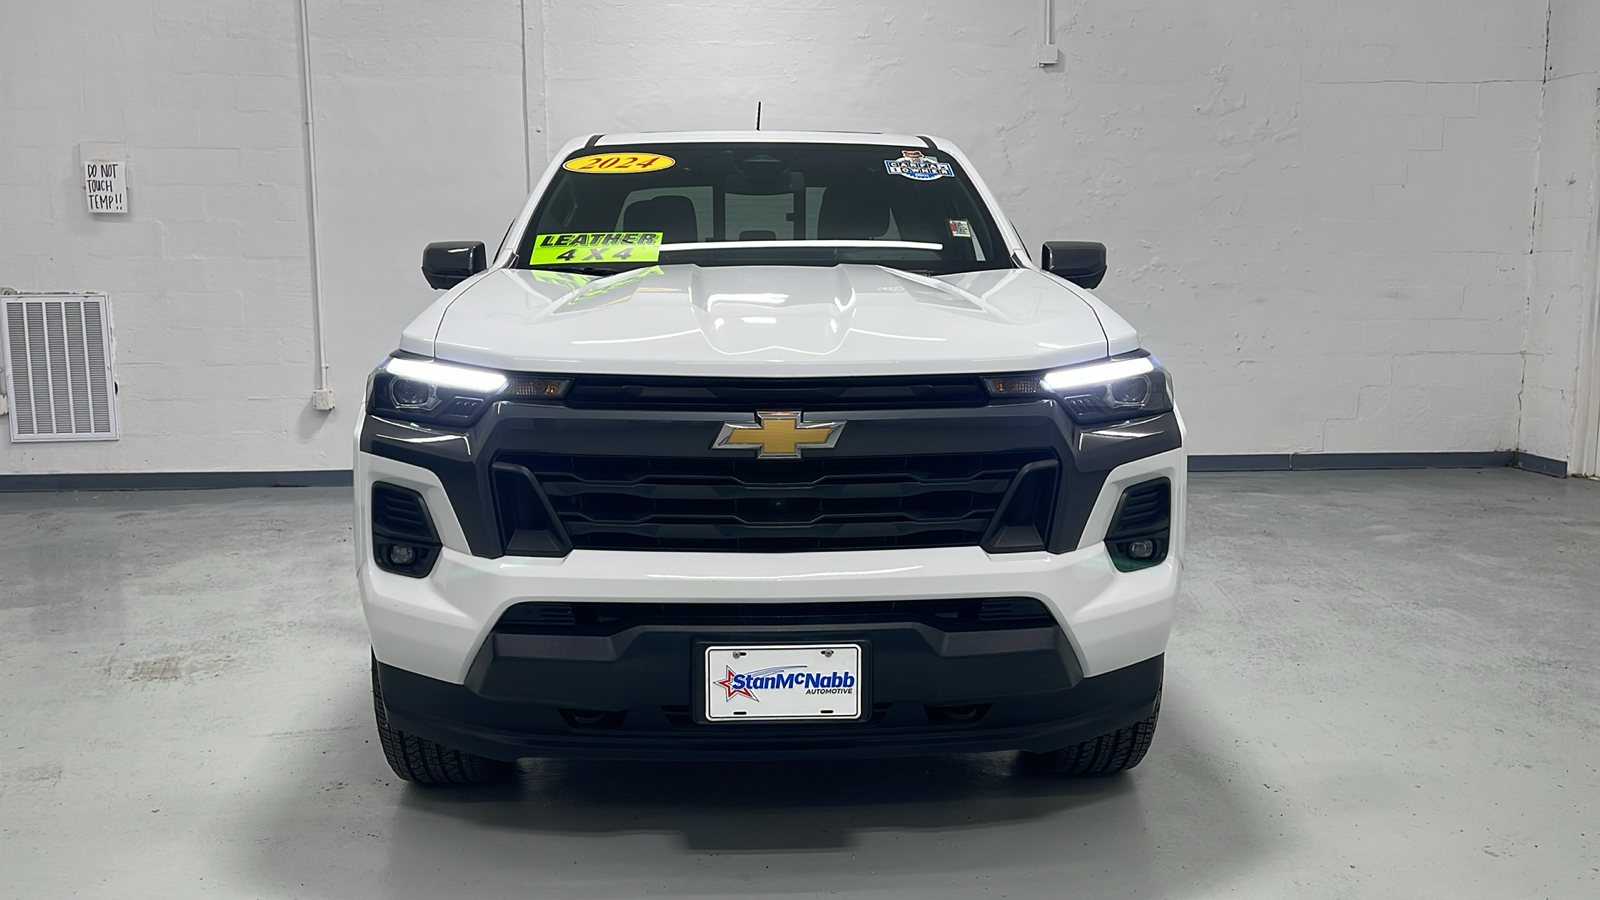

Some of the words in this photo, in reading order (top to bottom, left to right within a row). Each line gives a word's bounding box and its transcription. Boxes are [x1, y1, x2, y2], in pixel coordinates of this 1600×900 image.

[578, 156, 660, 170] 2024
[87, 164, 98, 178] DO
[100, 163, 119, 178] NOT
[87, 179, 113, 193] TOUCH
[88, 193, 123, 210] TEMP!!
[540, 233, 660, 247] LEATHER
